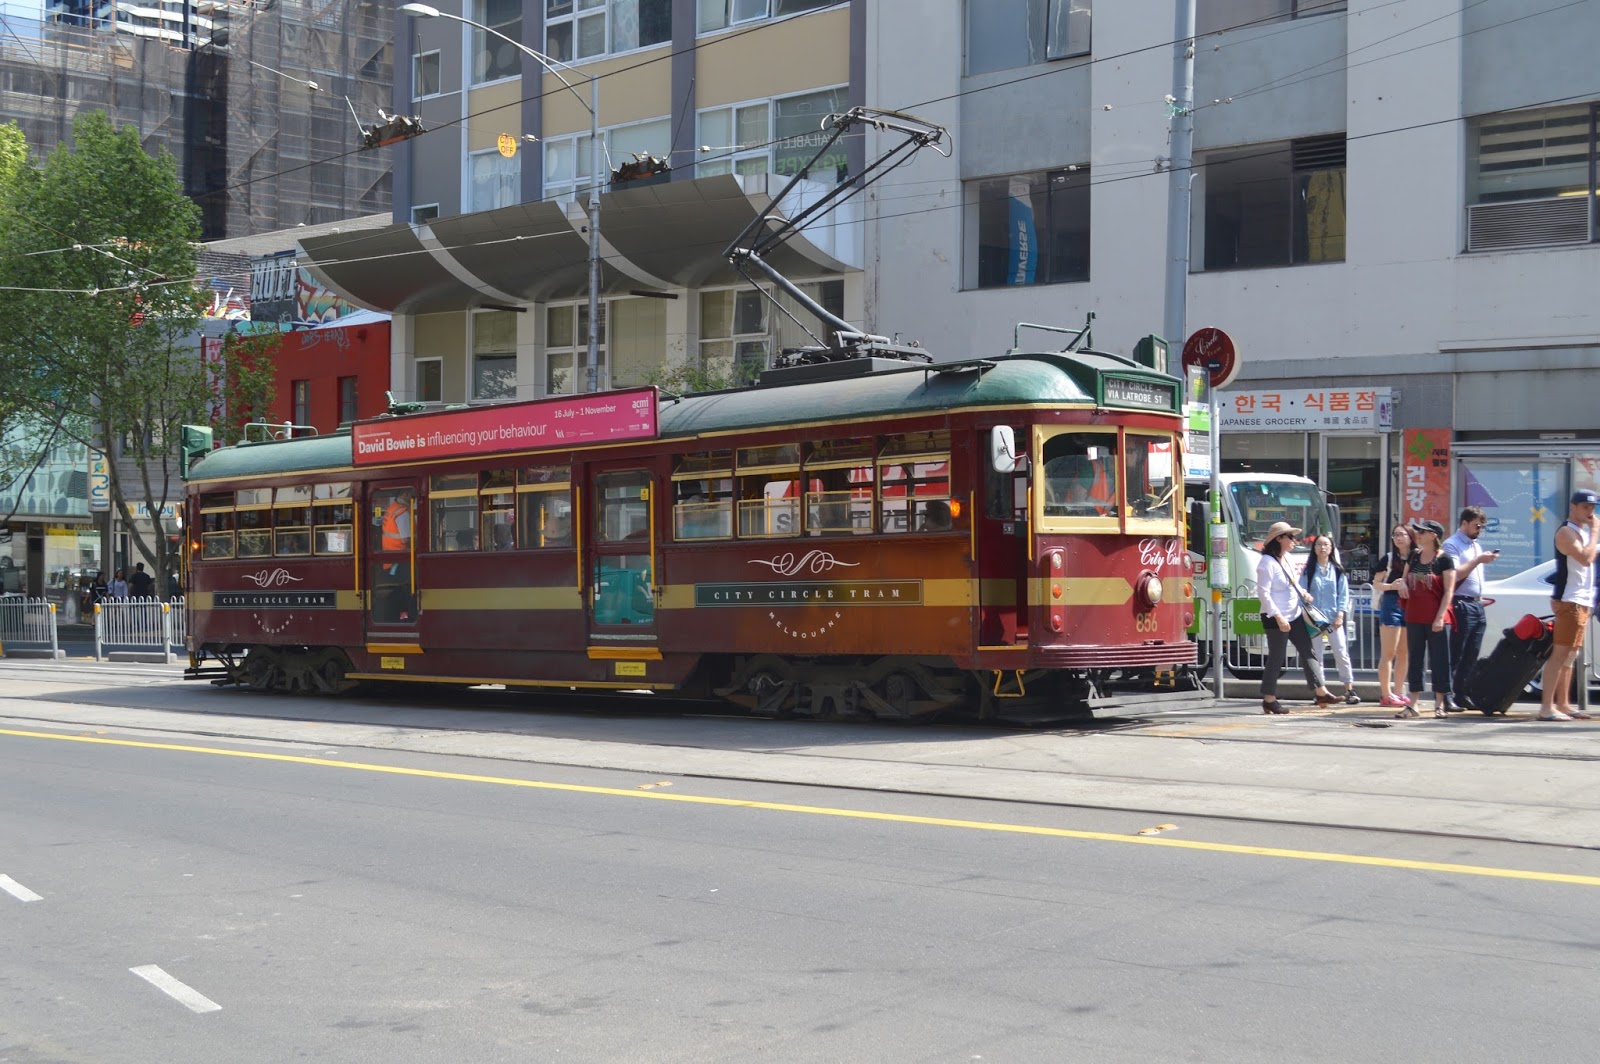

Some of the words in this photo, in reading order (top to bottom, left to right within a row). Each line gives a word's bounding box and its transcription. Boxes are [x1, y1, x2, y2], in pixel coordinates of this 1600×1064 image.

[499, 136, 513, 145] CUT
[500, 145, 514, 154] OFF
[1108, 379, 1125, 388] CITY
[1128, 381, 1154, 392] CIRCLE
[1107, 390, 1119, 399] VIA
[1122, 391, 1152, 403] LATROBE
[1154, 395, 1163, 404] ST
[1234, 394, 1281, 414] 한국
[1303, 391, 1376, 412] 식품점
[554, 410, 562, 418] 16
[562, 408, 574, 418] July
[580, 407, 585, 416] 1
[585, 404, 617, 415] November
[632, 397, 649, 409] acmi
[1219, 418, 1261, 426] JAPANESE
[1344, 416, 1368, 425] 食品店
[358, 438, 385, 454] David
[386, 435, 416, 451] Bowie
[417, 434, 426, 447] is
[427, 429, 475, 446] influencing
[477, 429, 497, 445] your
[500, 422, 547, 440] behaviour
[1138, 538, 1165, 573] City
[714, 591, 753, 600] CITY
[768, 590, 834, 599] CIRCLE
[850, 589, 900, 598] TRAM
[769, 611, 841, 639] MELBOURNE
[1136, 612, 1158, 632] 856
